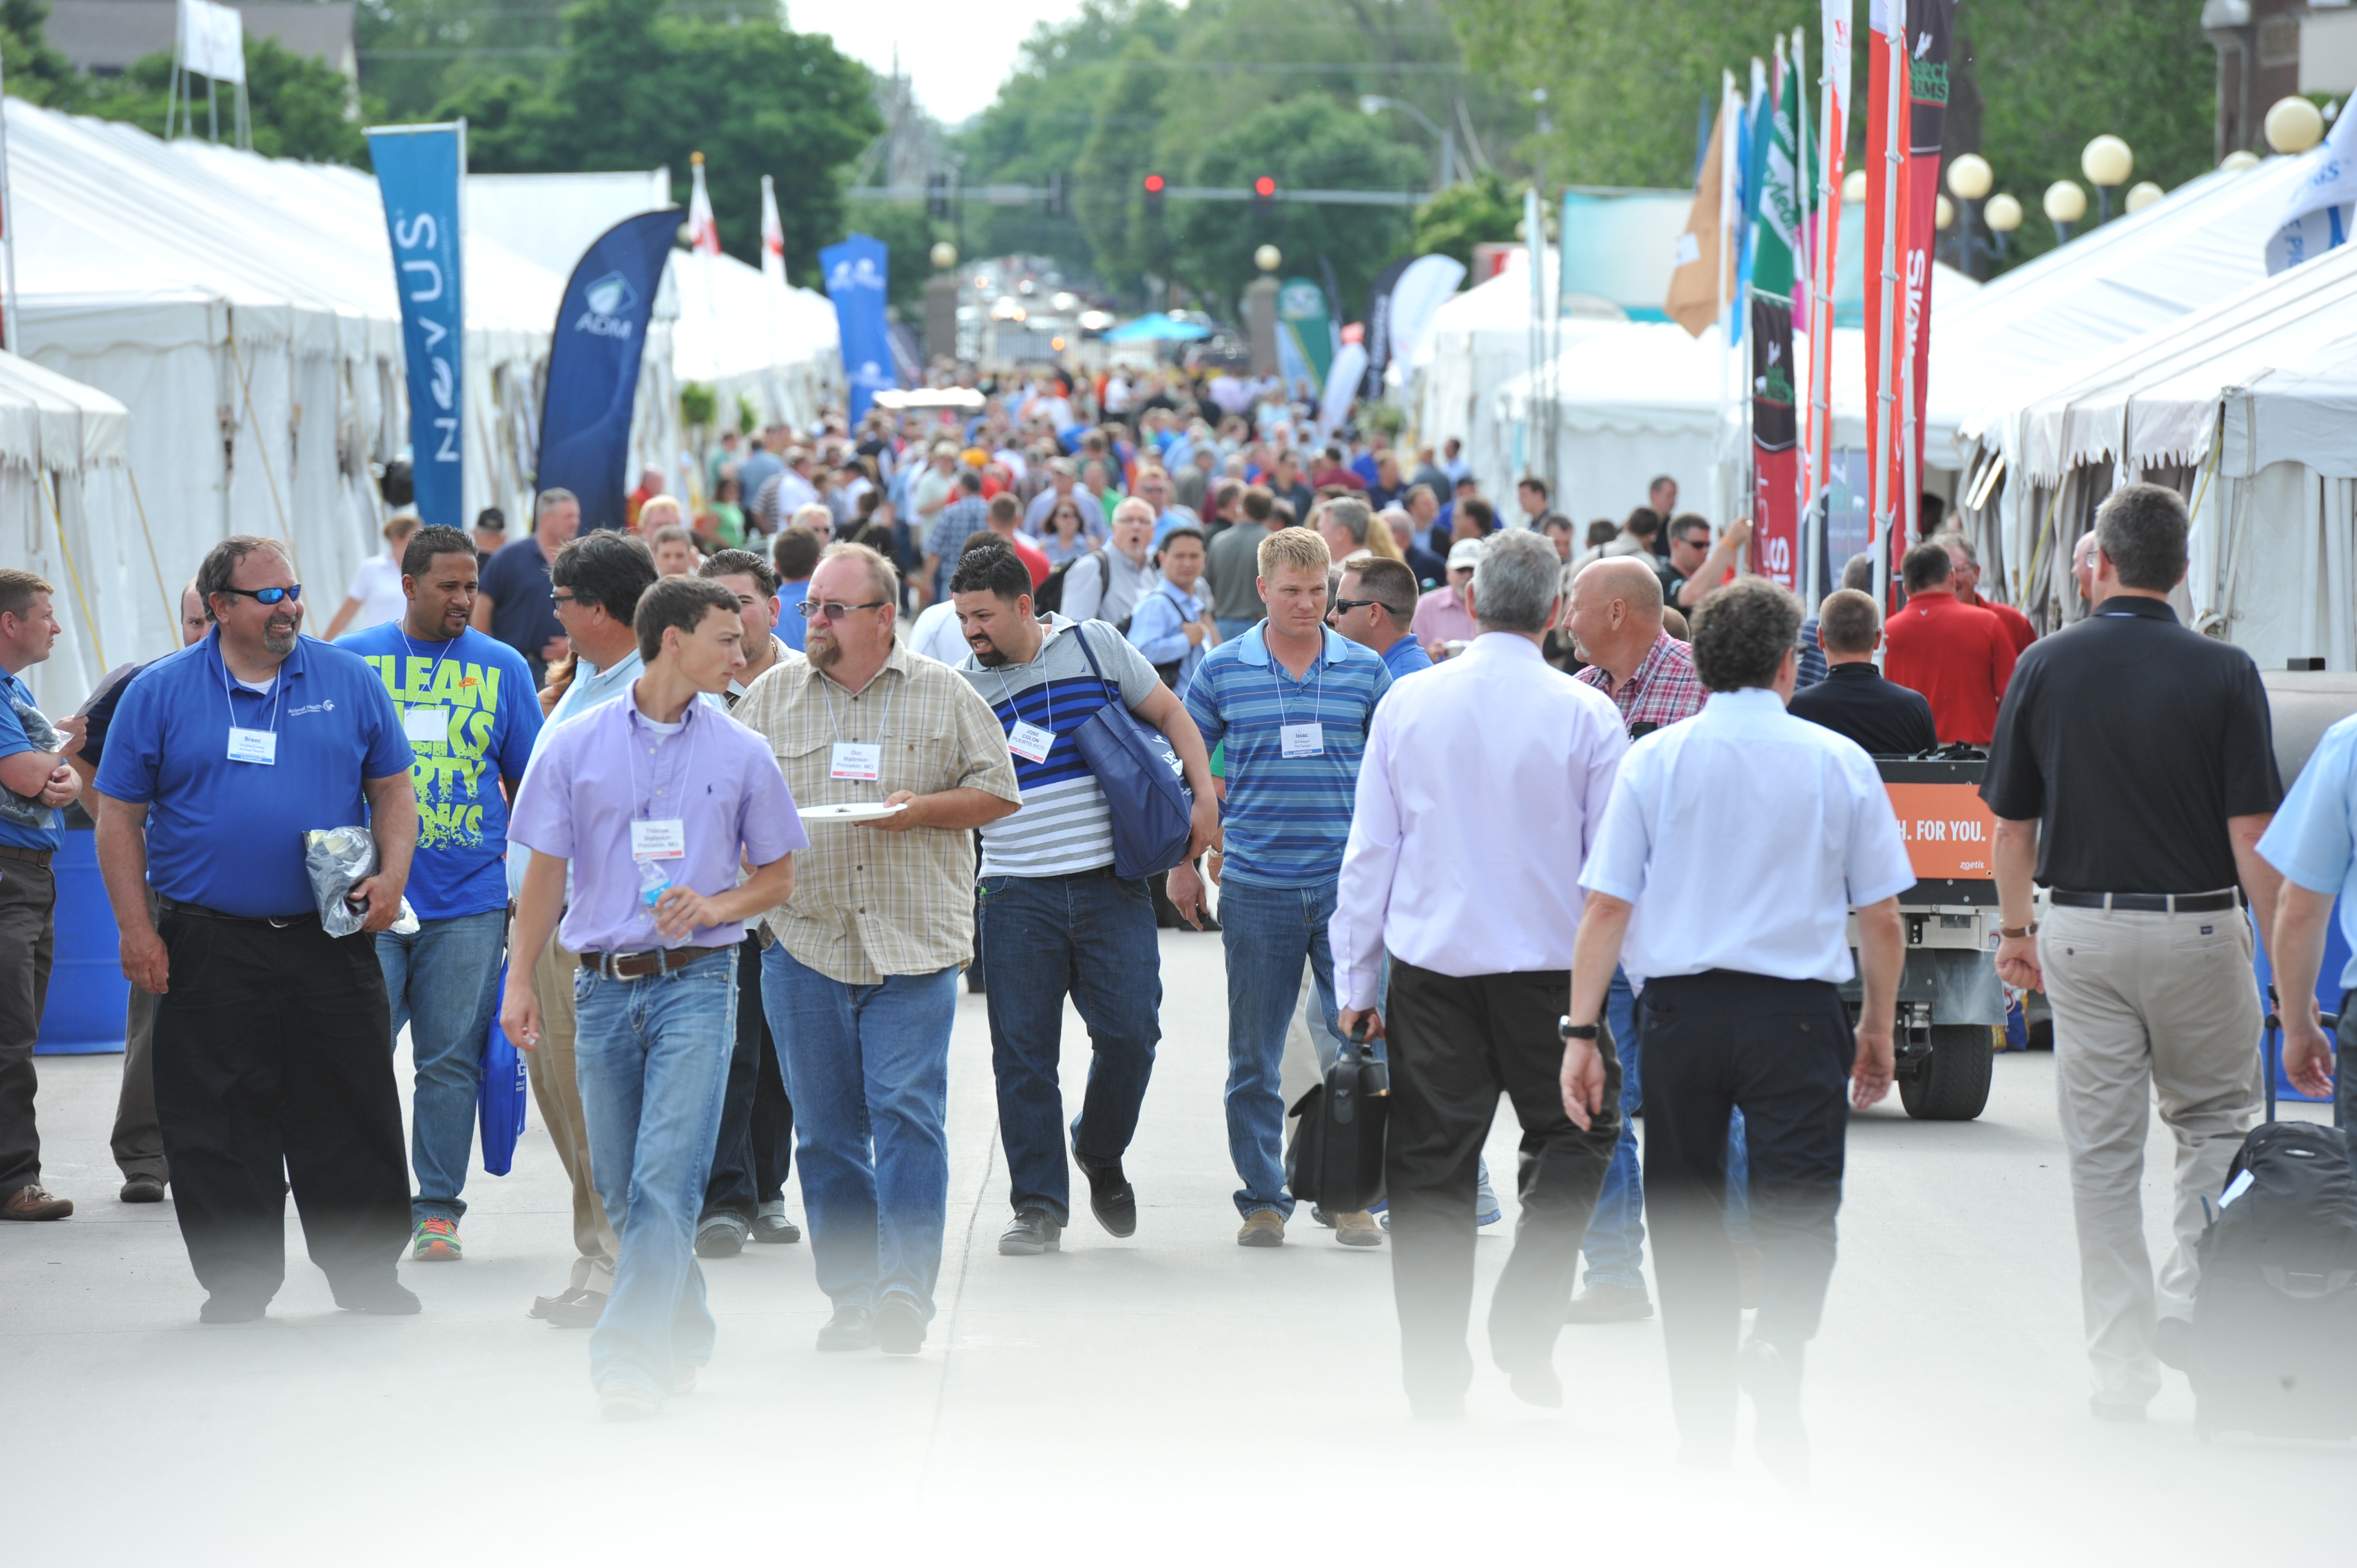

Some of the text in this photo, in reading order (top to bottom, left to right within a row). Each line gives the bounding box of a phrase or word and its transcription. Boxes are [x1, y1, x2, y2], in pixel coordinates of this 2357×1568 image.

[575, 312, 632, 341] ADM
[1026, 729, 1039, 737] JOSE
[1012, 736, 1032, 746] PUERTO
[1022, 734, 1040, 743] COLON
[1917, 820, 1946, 841] FOR
[1949, 821, 1987, 842] YOU.
[1960, 860, 1984, 870] zoetis
